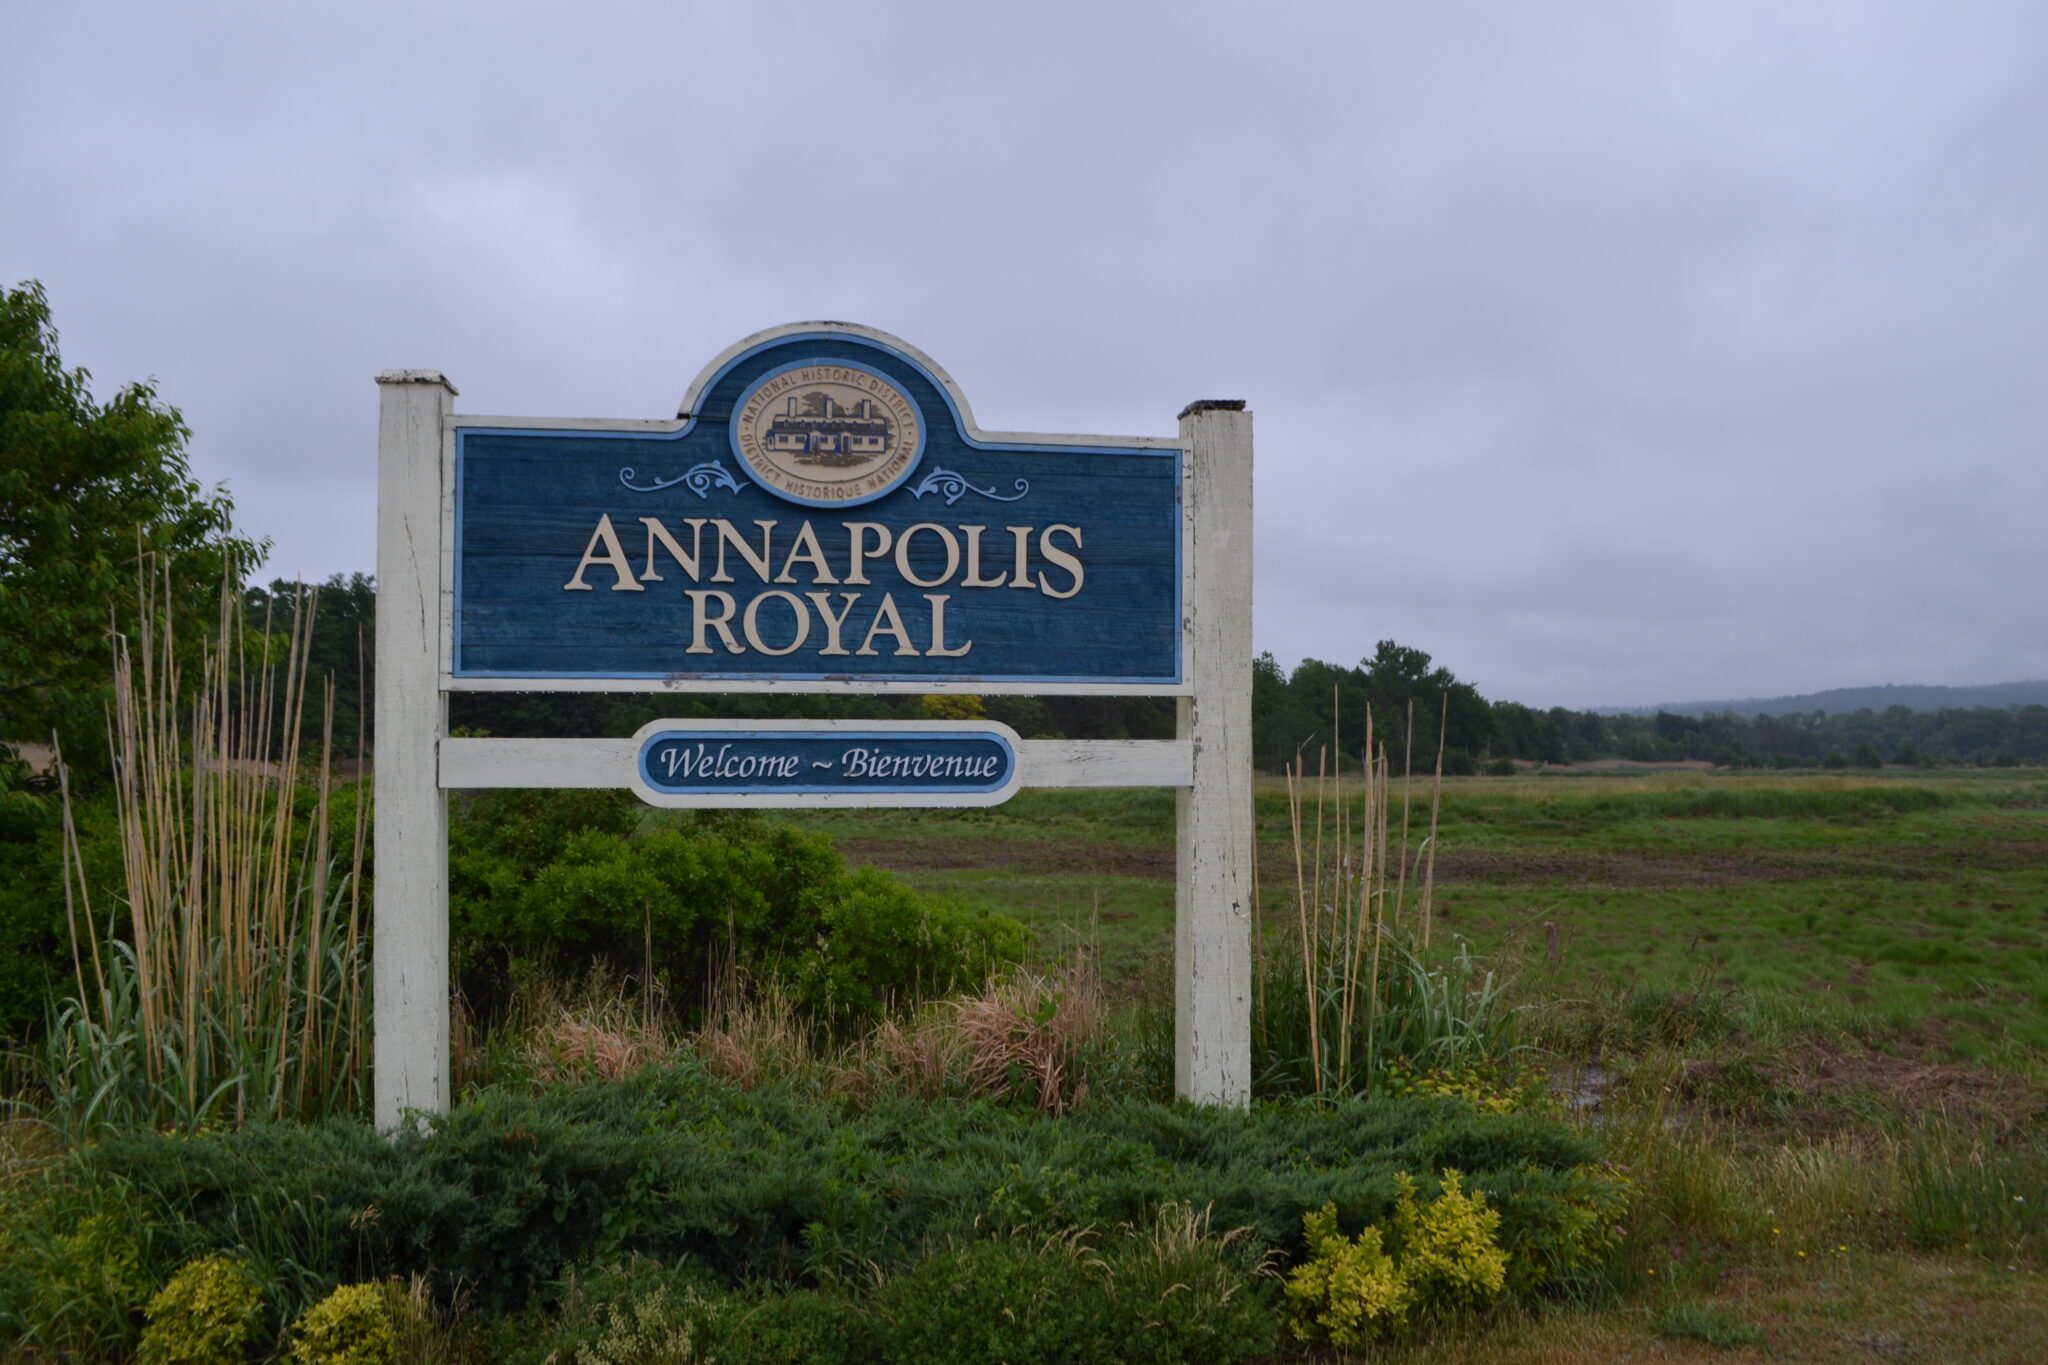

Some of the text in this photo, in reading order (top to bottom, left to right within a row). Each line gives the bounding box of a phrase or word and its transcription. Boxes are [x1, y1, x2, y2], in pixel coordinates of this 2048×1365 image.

[742, 368, 915, 428] NATIONAL HISTORIC DISTRICT
[784, 480, 861, 500] HISTORIQUE
[868, 440, 915, 488] NATIONAL
[563, 513, 1084, 599] ANNAPOLIS
[684, 590, 972, 657] ROYAL
[660, 743, 799, 778] Welcome
[842, 747, 998, 778] Bienvenue
